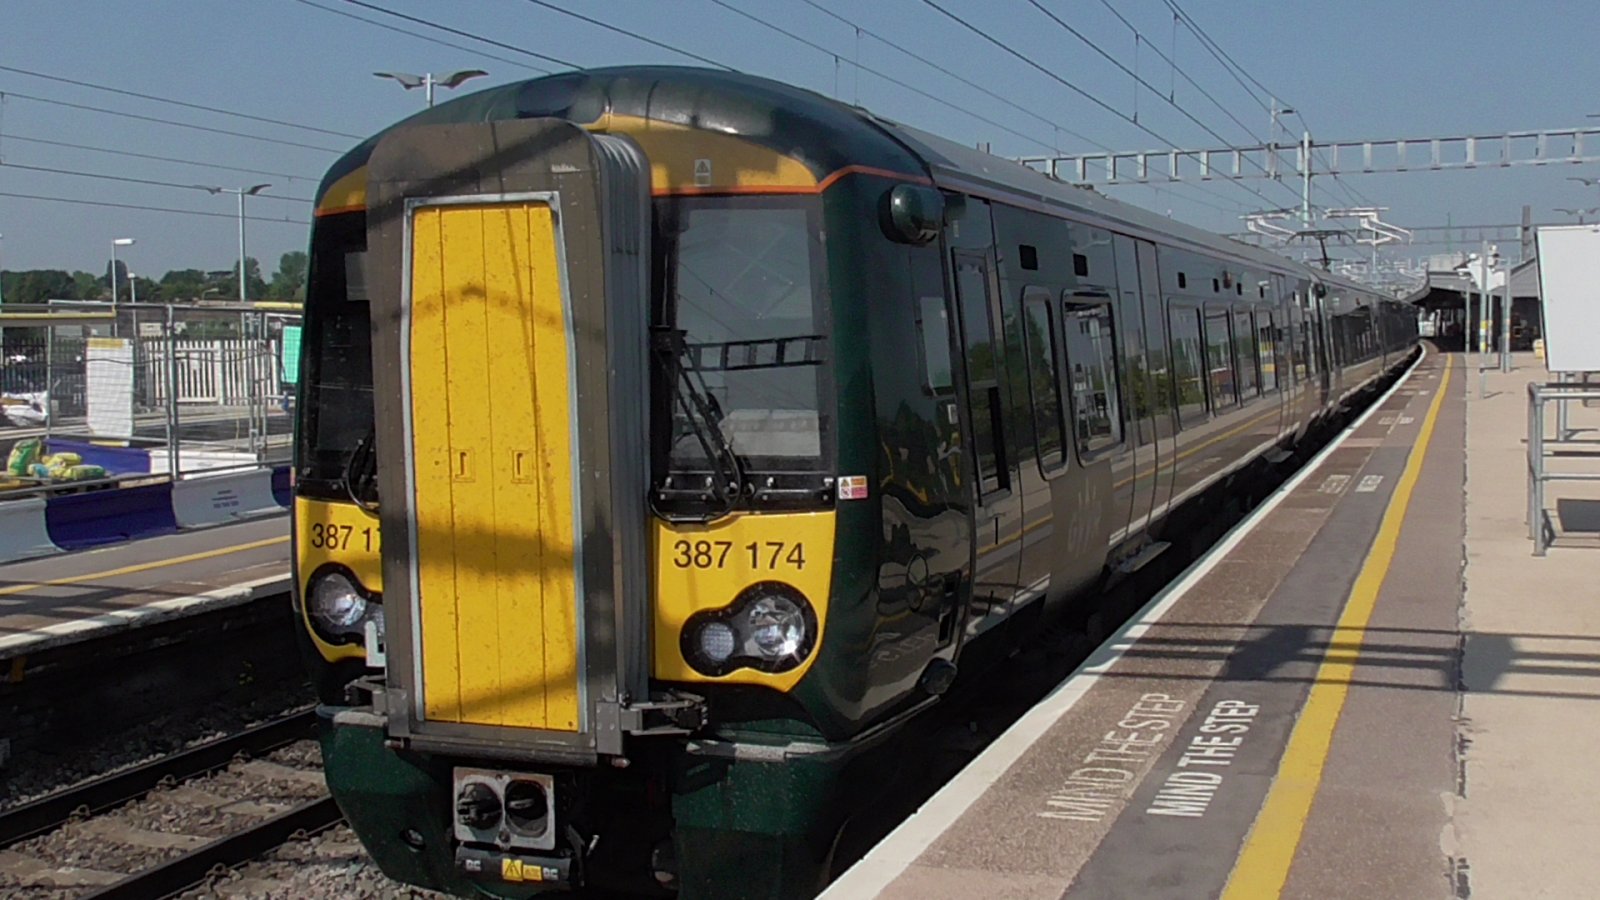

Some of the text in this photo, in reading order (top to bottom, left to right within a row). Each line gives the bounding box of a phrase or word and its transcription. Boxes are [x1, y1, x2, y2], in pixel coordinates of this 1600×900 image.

[311, 522, 354, 551] 387
[673, 539, 806, 570] 387 174
[1036, 692, 1187, 822] MIND THE STEP
[1146, 699, 1261, 817] MIND THE STEP
